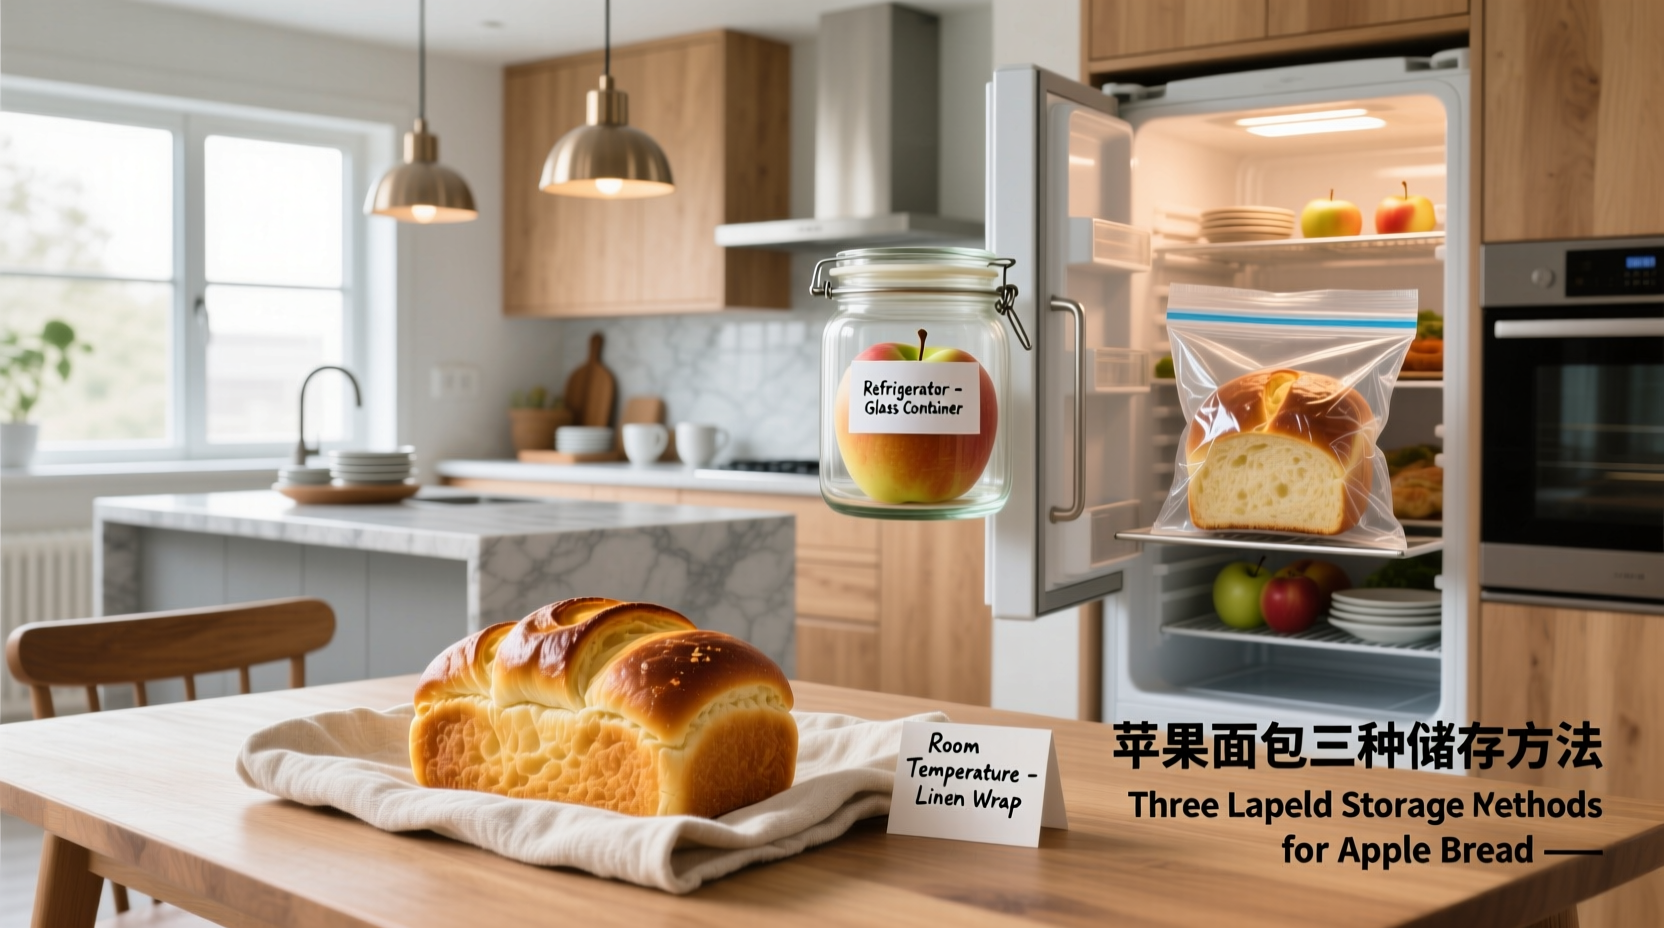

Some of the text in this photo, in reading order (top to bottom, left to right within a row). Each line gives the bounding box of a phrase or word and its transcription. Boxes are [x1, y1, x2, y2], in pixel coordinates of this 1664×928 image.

[863, 380, 950, 401] Refrigerator
[864, 399, 899, 415] Glass
[928, 731, 980, 754] Room
[906, 757, 1020, 787] Temperature
[915, 785, 1022, 819] Linen Wrap
